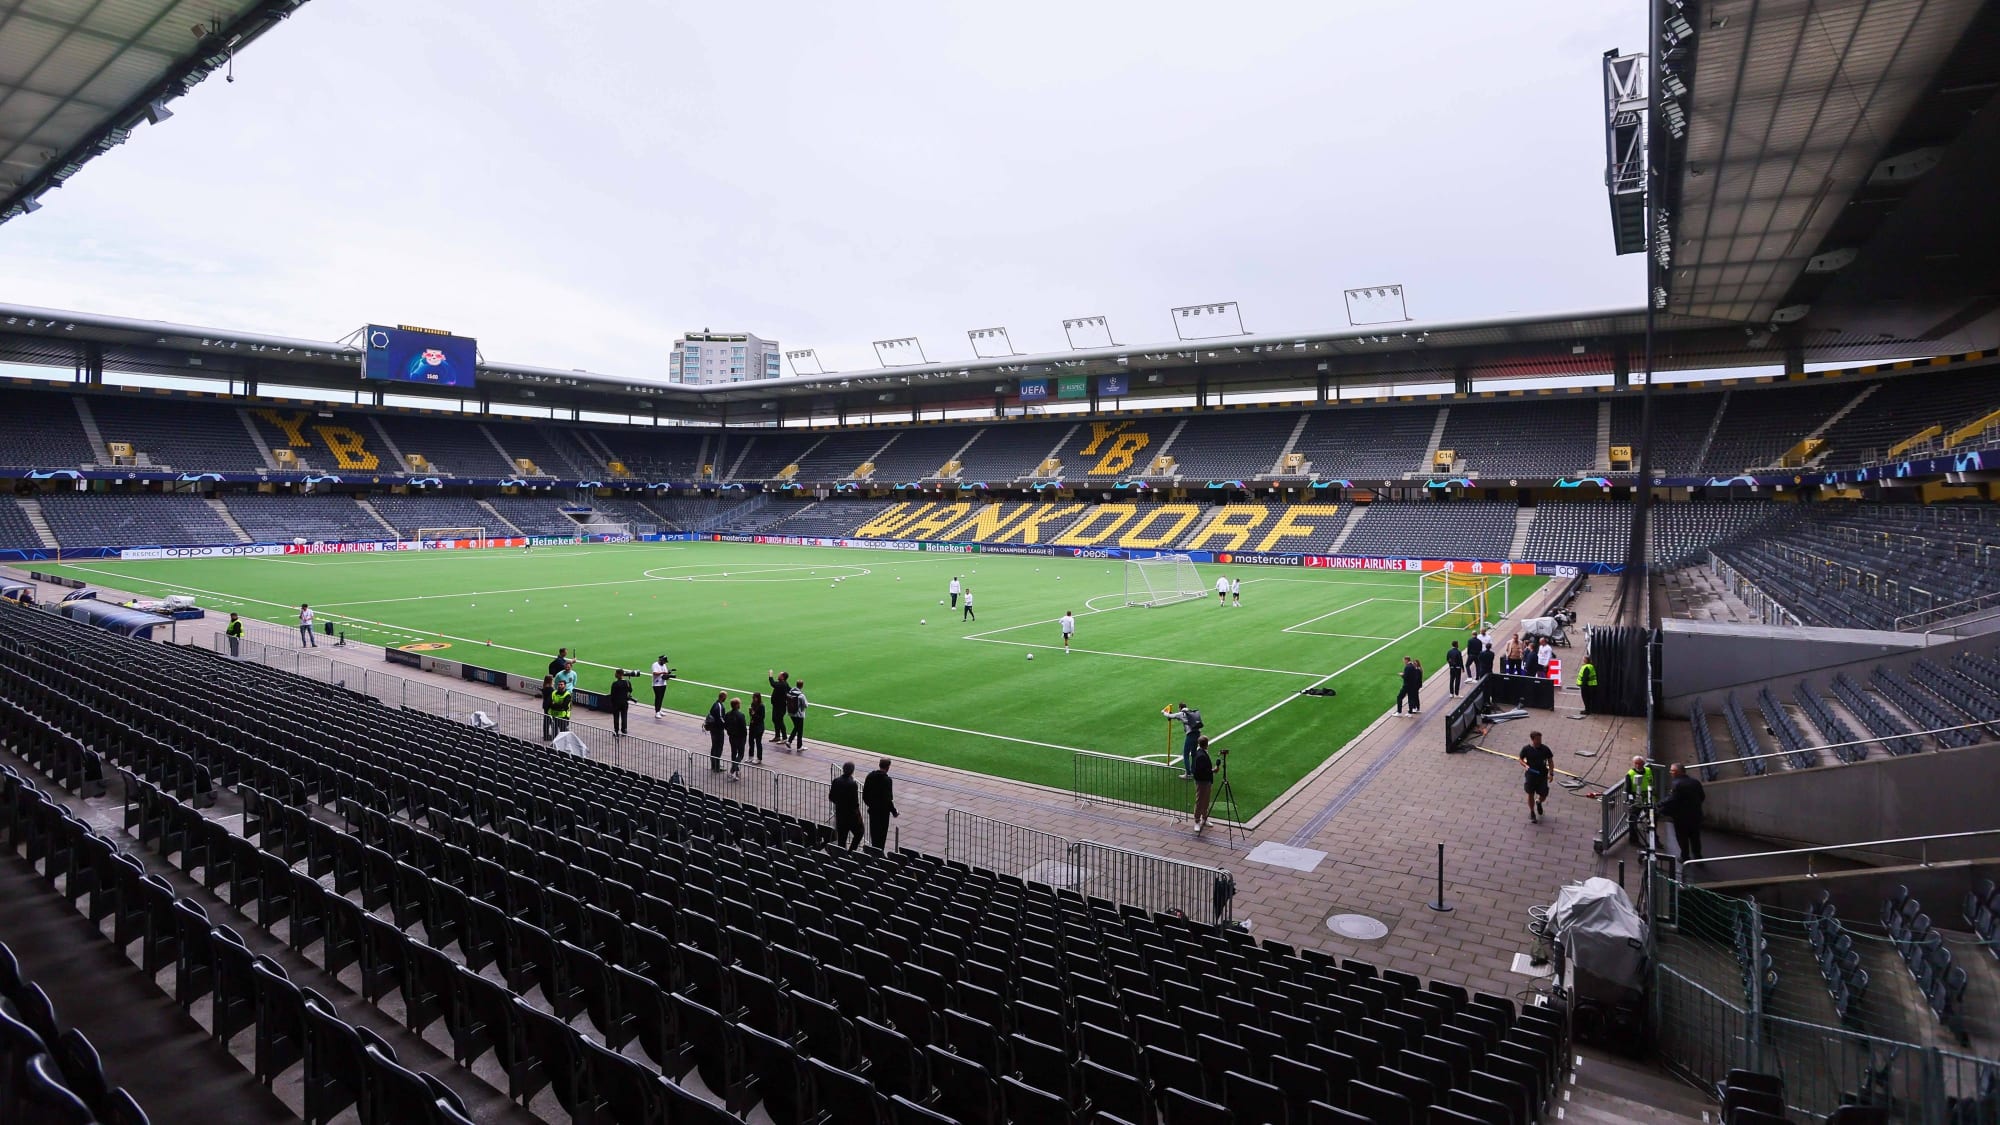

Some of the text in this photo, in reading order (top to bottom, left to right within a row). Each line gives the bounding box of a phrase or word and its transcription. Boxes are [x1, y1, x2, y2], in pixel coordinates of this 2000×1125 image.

[1021, 385, 1046, 395] UEFA
[855, 502, 1339, 550] WANKDORF
[532, 536, 574, 547] Heineken
[722, 534, 752, 543] mastercard
[807, 538, 822, 546] FedEx
[832, 539, 848, 547] FedEx
[303, 542, 375, 554] TURKISH AIRLINES
[381, 542, 408, 551] FedEx
[422, 541, 447, 550] FedEx
[864, 540, 887, 549] oppo
[892, 541, 915, 550] oppo
[925, 543, 965, 553] Heineken
[132, 550, 160, 558] RESPECT
[166, 546, 213, 558] oppo
[222, 545, 265, 557] oppo
[1082, 549, 1109, 559] pepsi
[1235, 553, 1298, 565] mastercard
[1325, 556, 1403, 571] TURKISH AIRLINES
